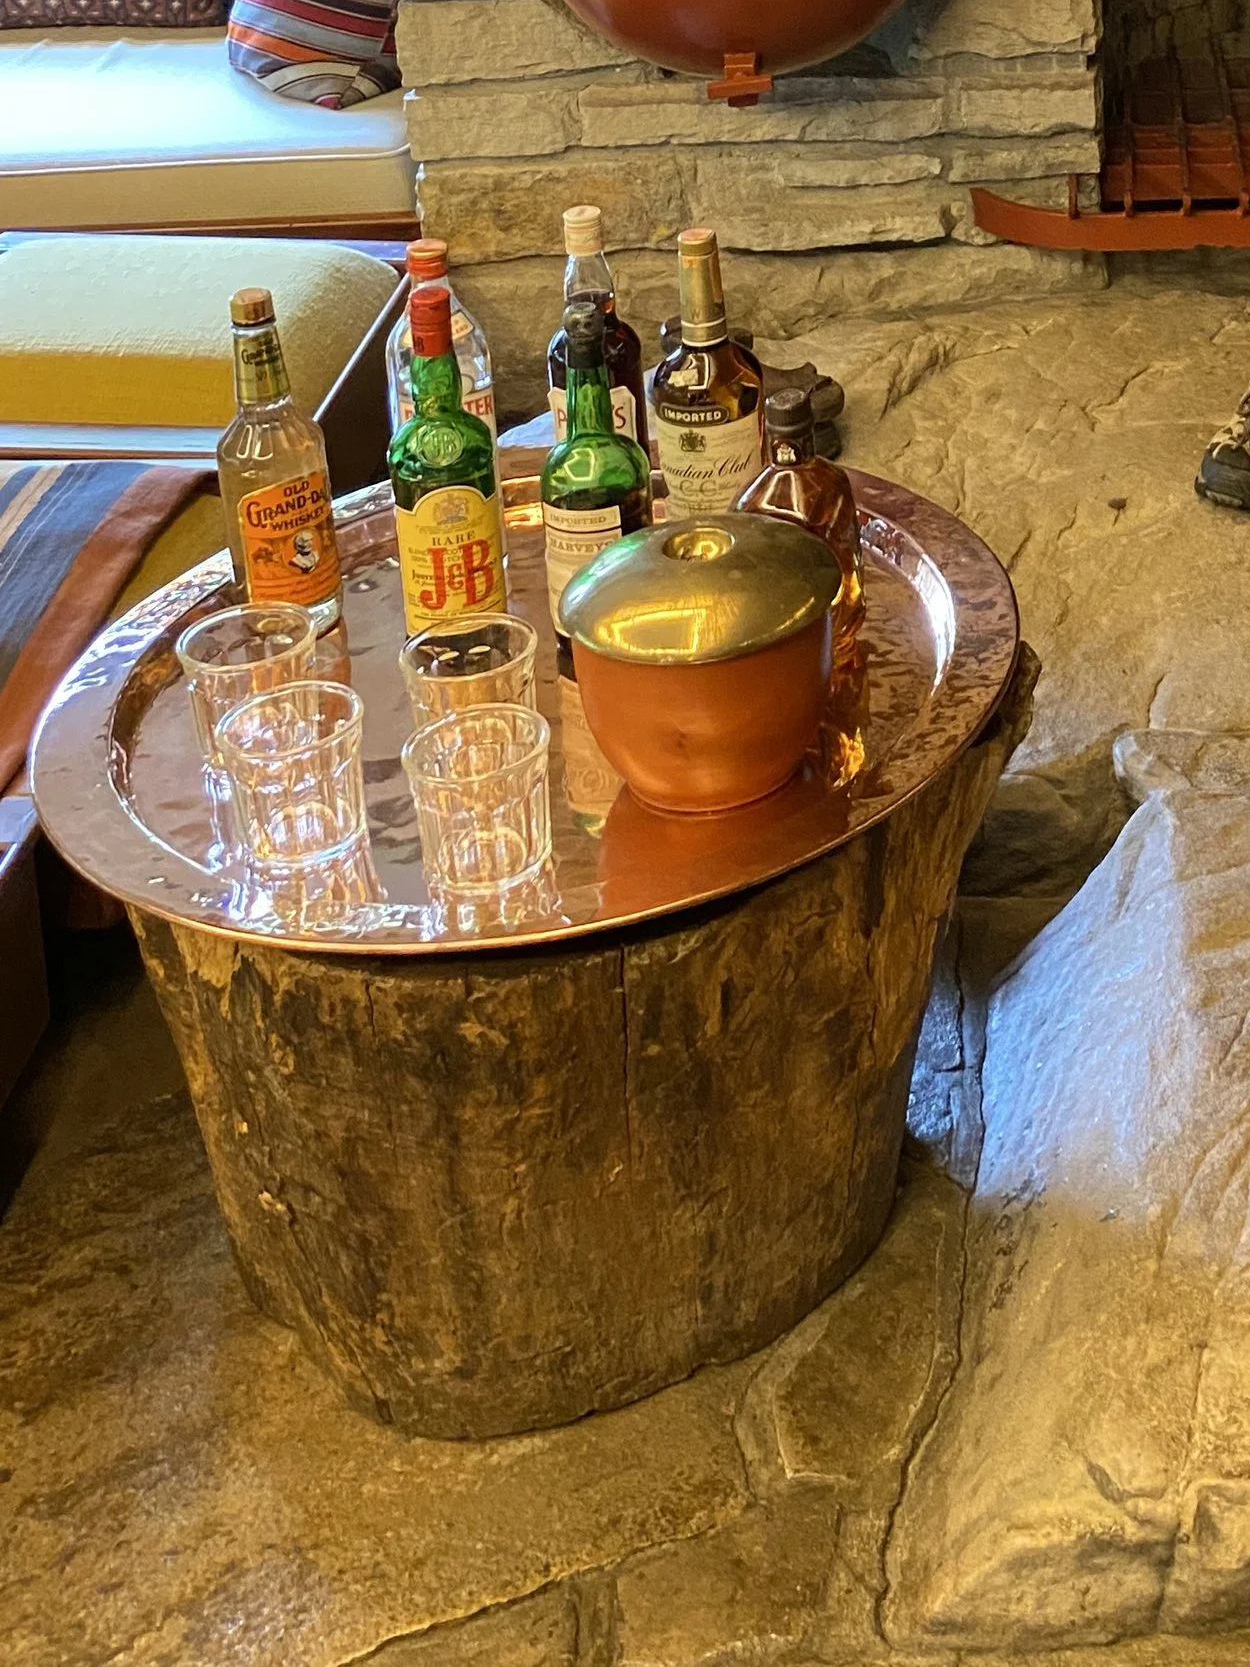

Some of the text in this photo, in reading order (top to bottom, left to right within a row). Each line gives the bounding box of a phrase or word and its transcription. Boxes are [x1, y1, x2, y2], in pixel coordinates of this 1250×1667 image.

[664, 408, 722, 423] IMPORTED
[662, 448, 755, 479] anadian Club
[283, 480, 309, 498] OLD
[271, 505, 325, 531] WHISKEY
[550, 512, 607, 526] IMPORTED
[432, 530, 475, 546] RARE
[419, 538, 494, 611] J&B
